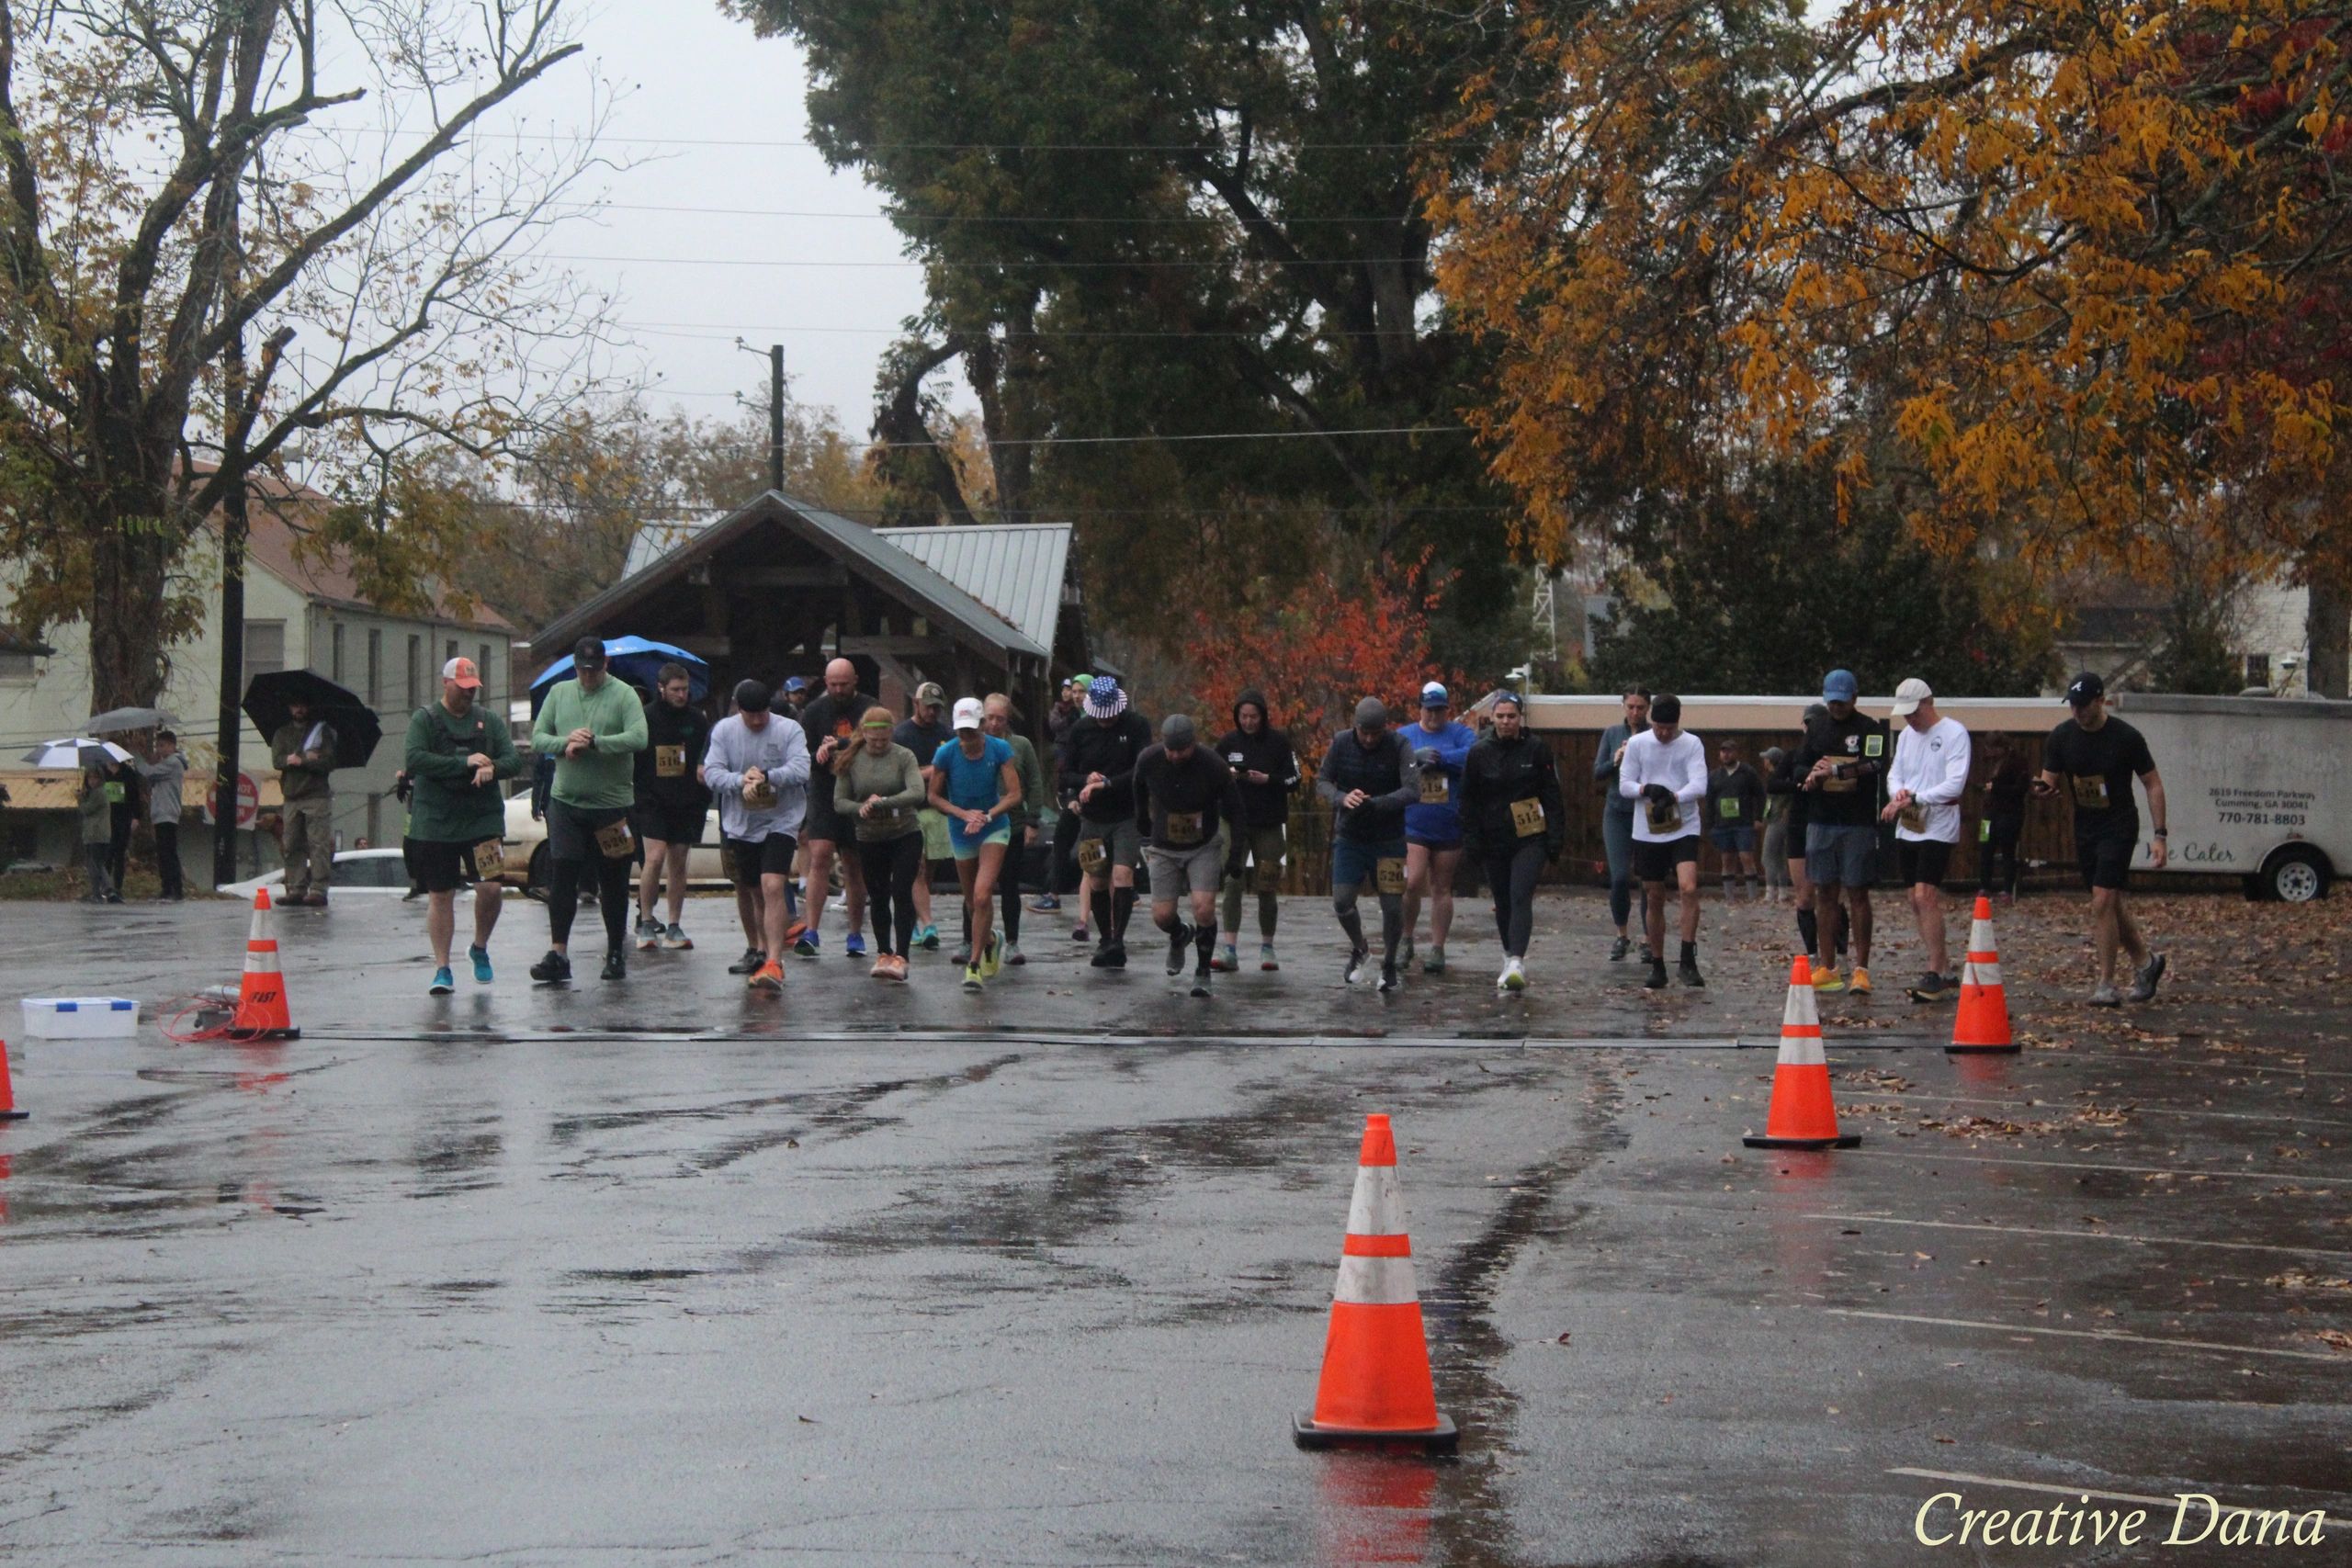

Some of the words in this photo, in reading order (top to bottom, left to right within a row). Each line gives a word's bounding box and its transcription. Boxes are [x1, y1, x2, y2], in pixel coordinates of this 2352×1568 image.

[2233, 789, 2275, 798] Freedom
[2278, 790, 2315, 801] Parkway
[2265, 800, 2278, 808] GA
[2219, 812, 2306, 825] 770-781-8803
[2184, 842, 2236, 862] Cater
